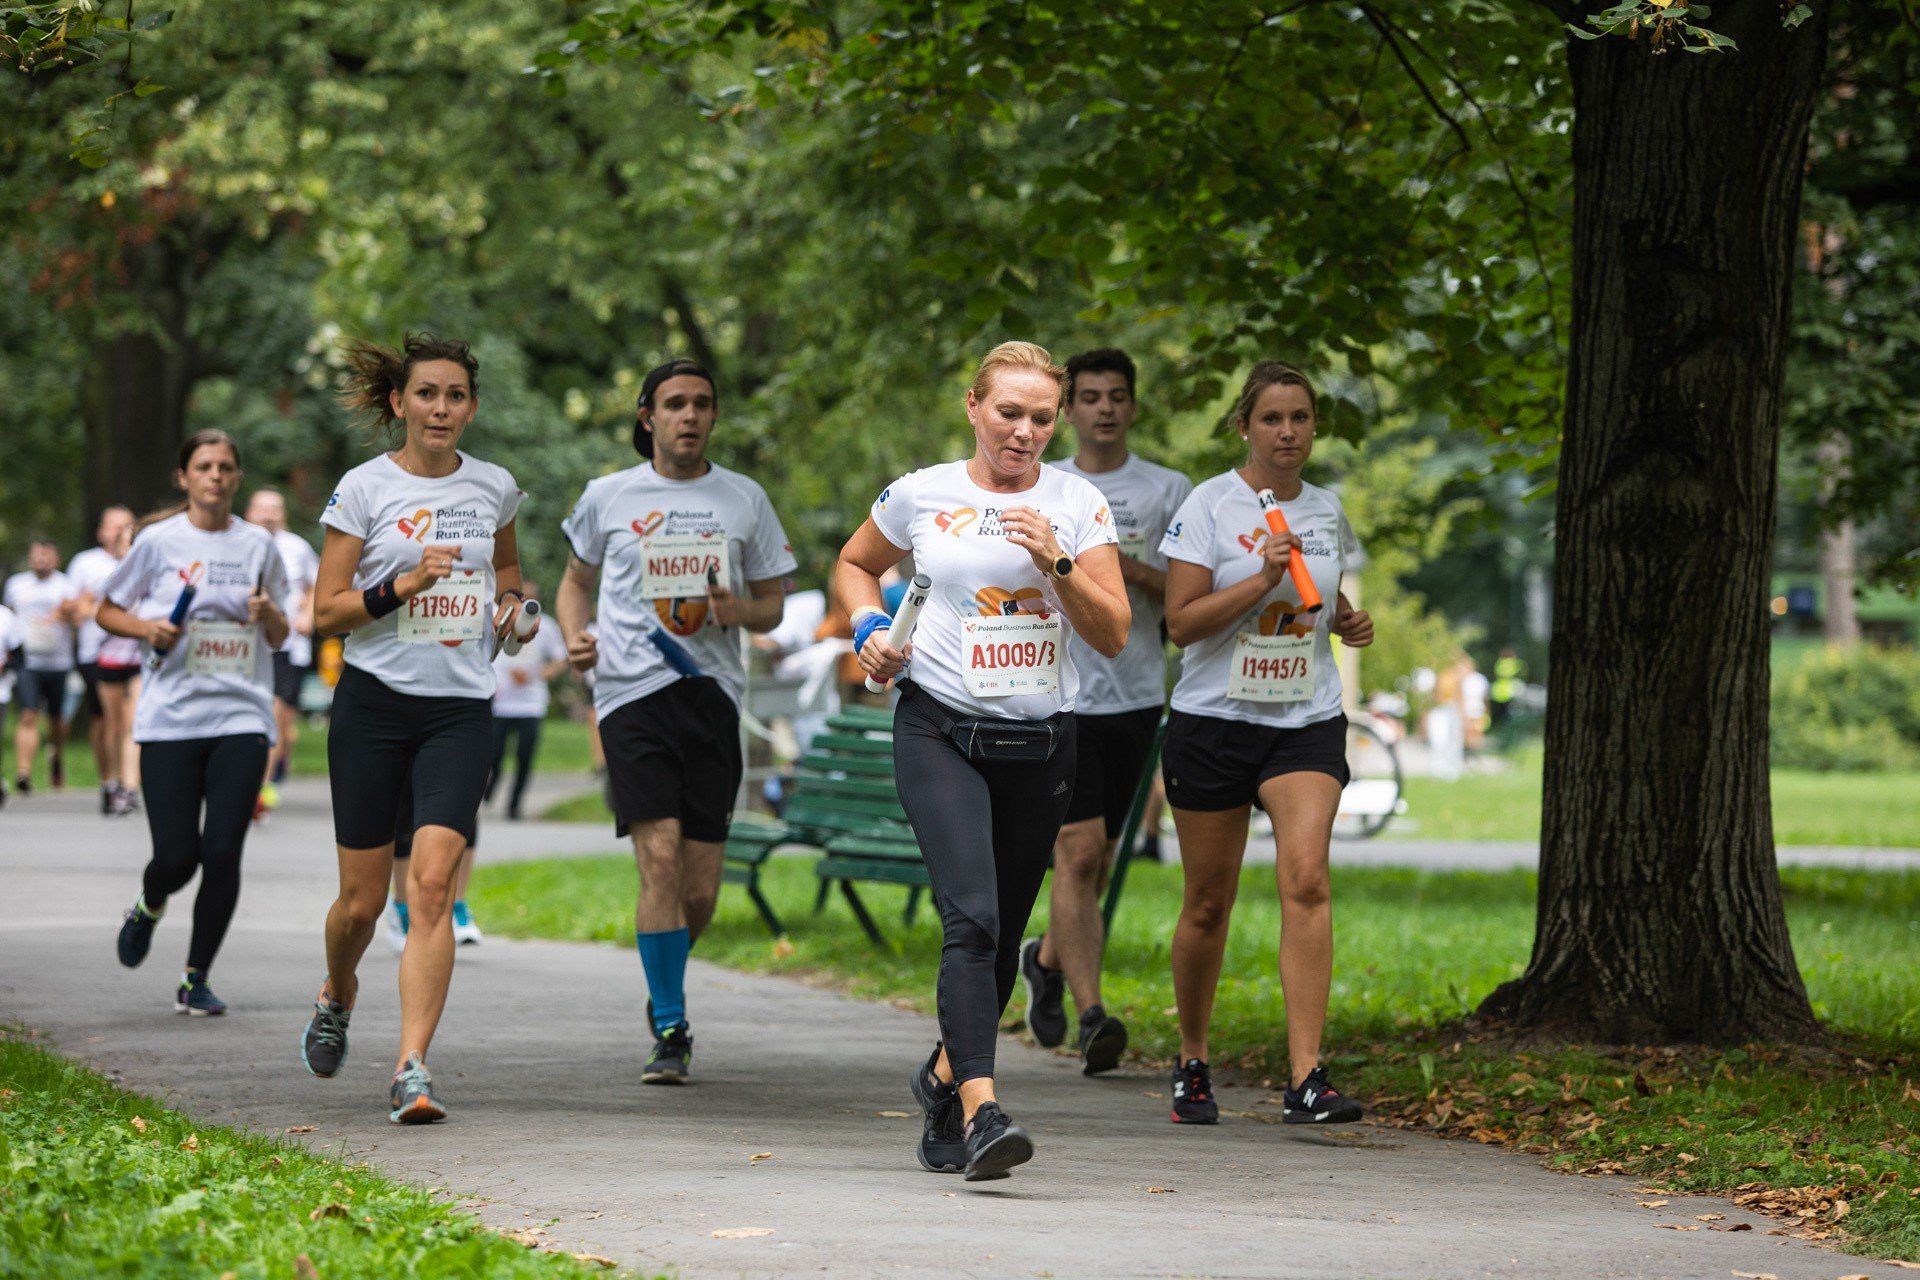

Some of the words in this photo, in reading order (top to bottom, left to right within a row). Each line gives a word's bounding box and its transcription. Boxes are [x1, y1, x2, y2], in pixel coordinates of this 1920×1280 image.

[437, 508, 477, 519] Poland
[436, 530, 460, 540] Run
[463, 529, 492, 539] 2022
[648, 554, 720, 577] N1670/3
[409, 595, 478, 618] P1796/3
[971, 640, 1056, 669] A1009/3
